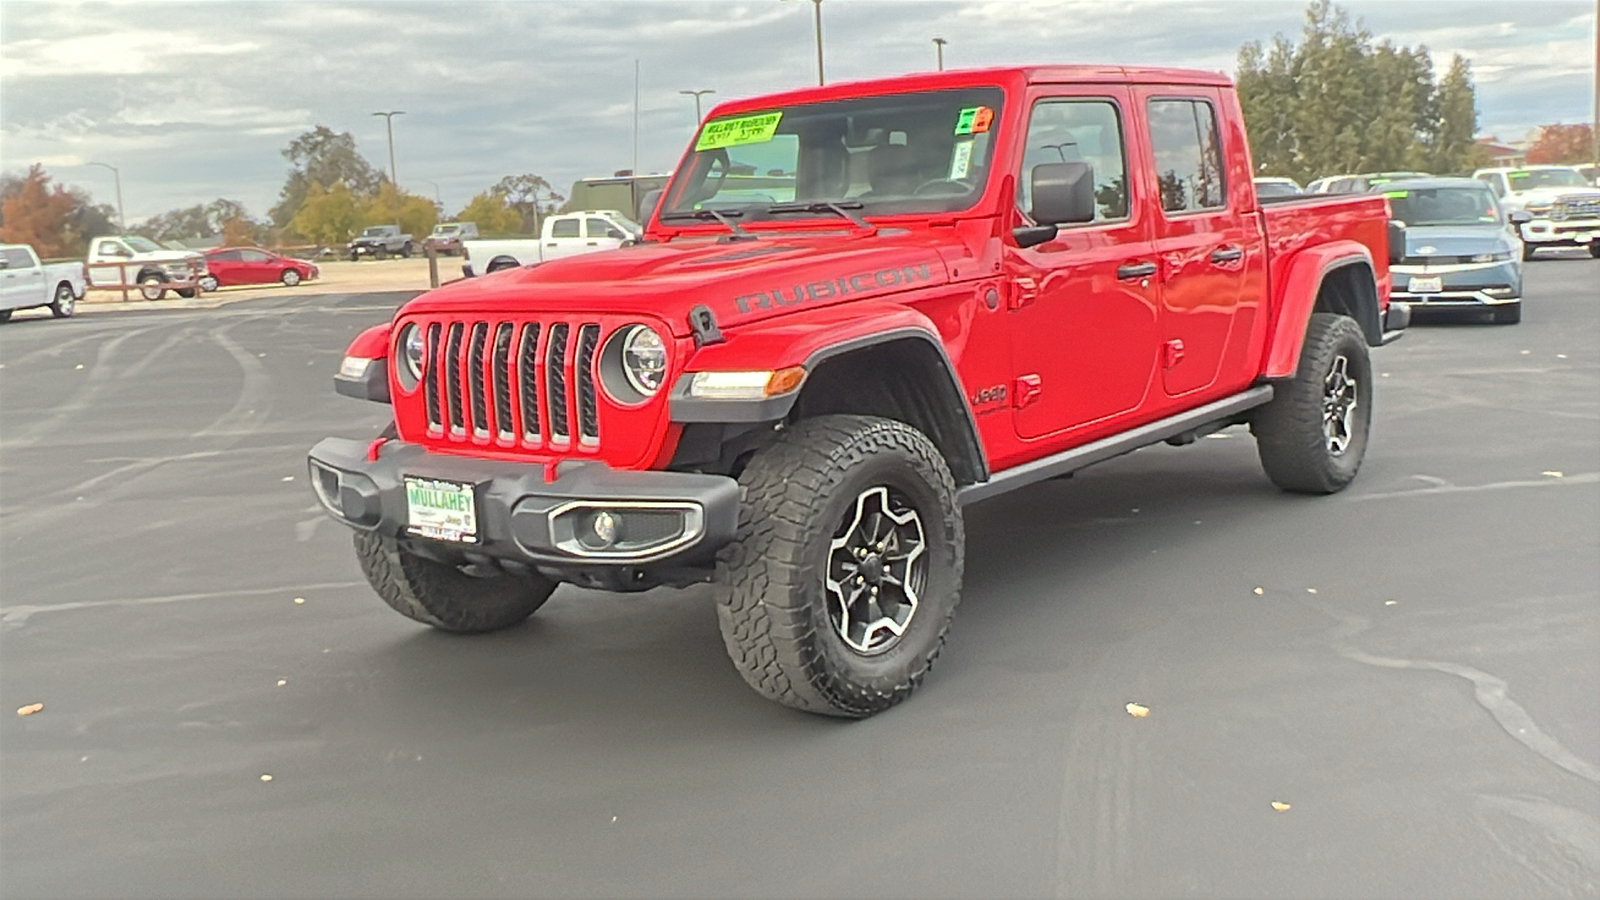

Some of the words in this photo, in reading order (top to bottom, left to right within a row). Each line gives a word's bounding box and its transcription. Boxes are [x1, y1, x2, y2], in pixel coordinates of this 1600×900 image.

[735, 263, 929, 313] RUBICON
[970, 384, 1007, 406] Jeep
[410, 489, 471, 512] MULLAHEY
